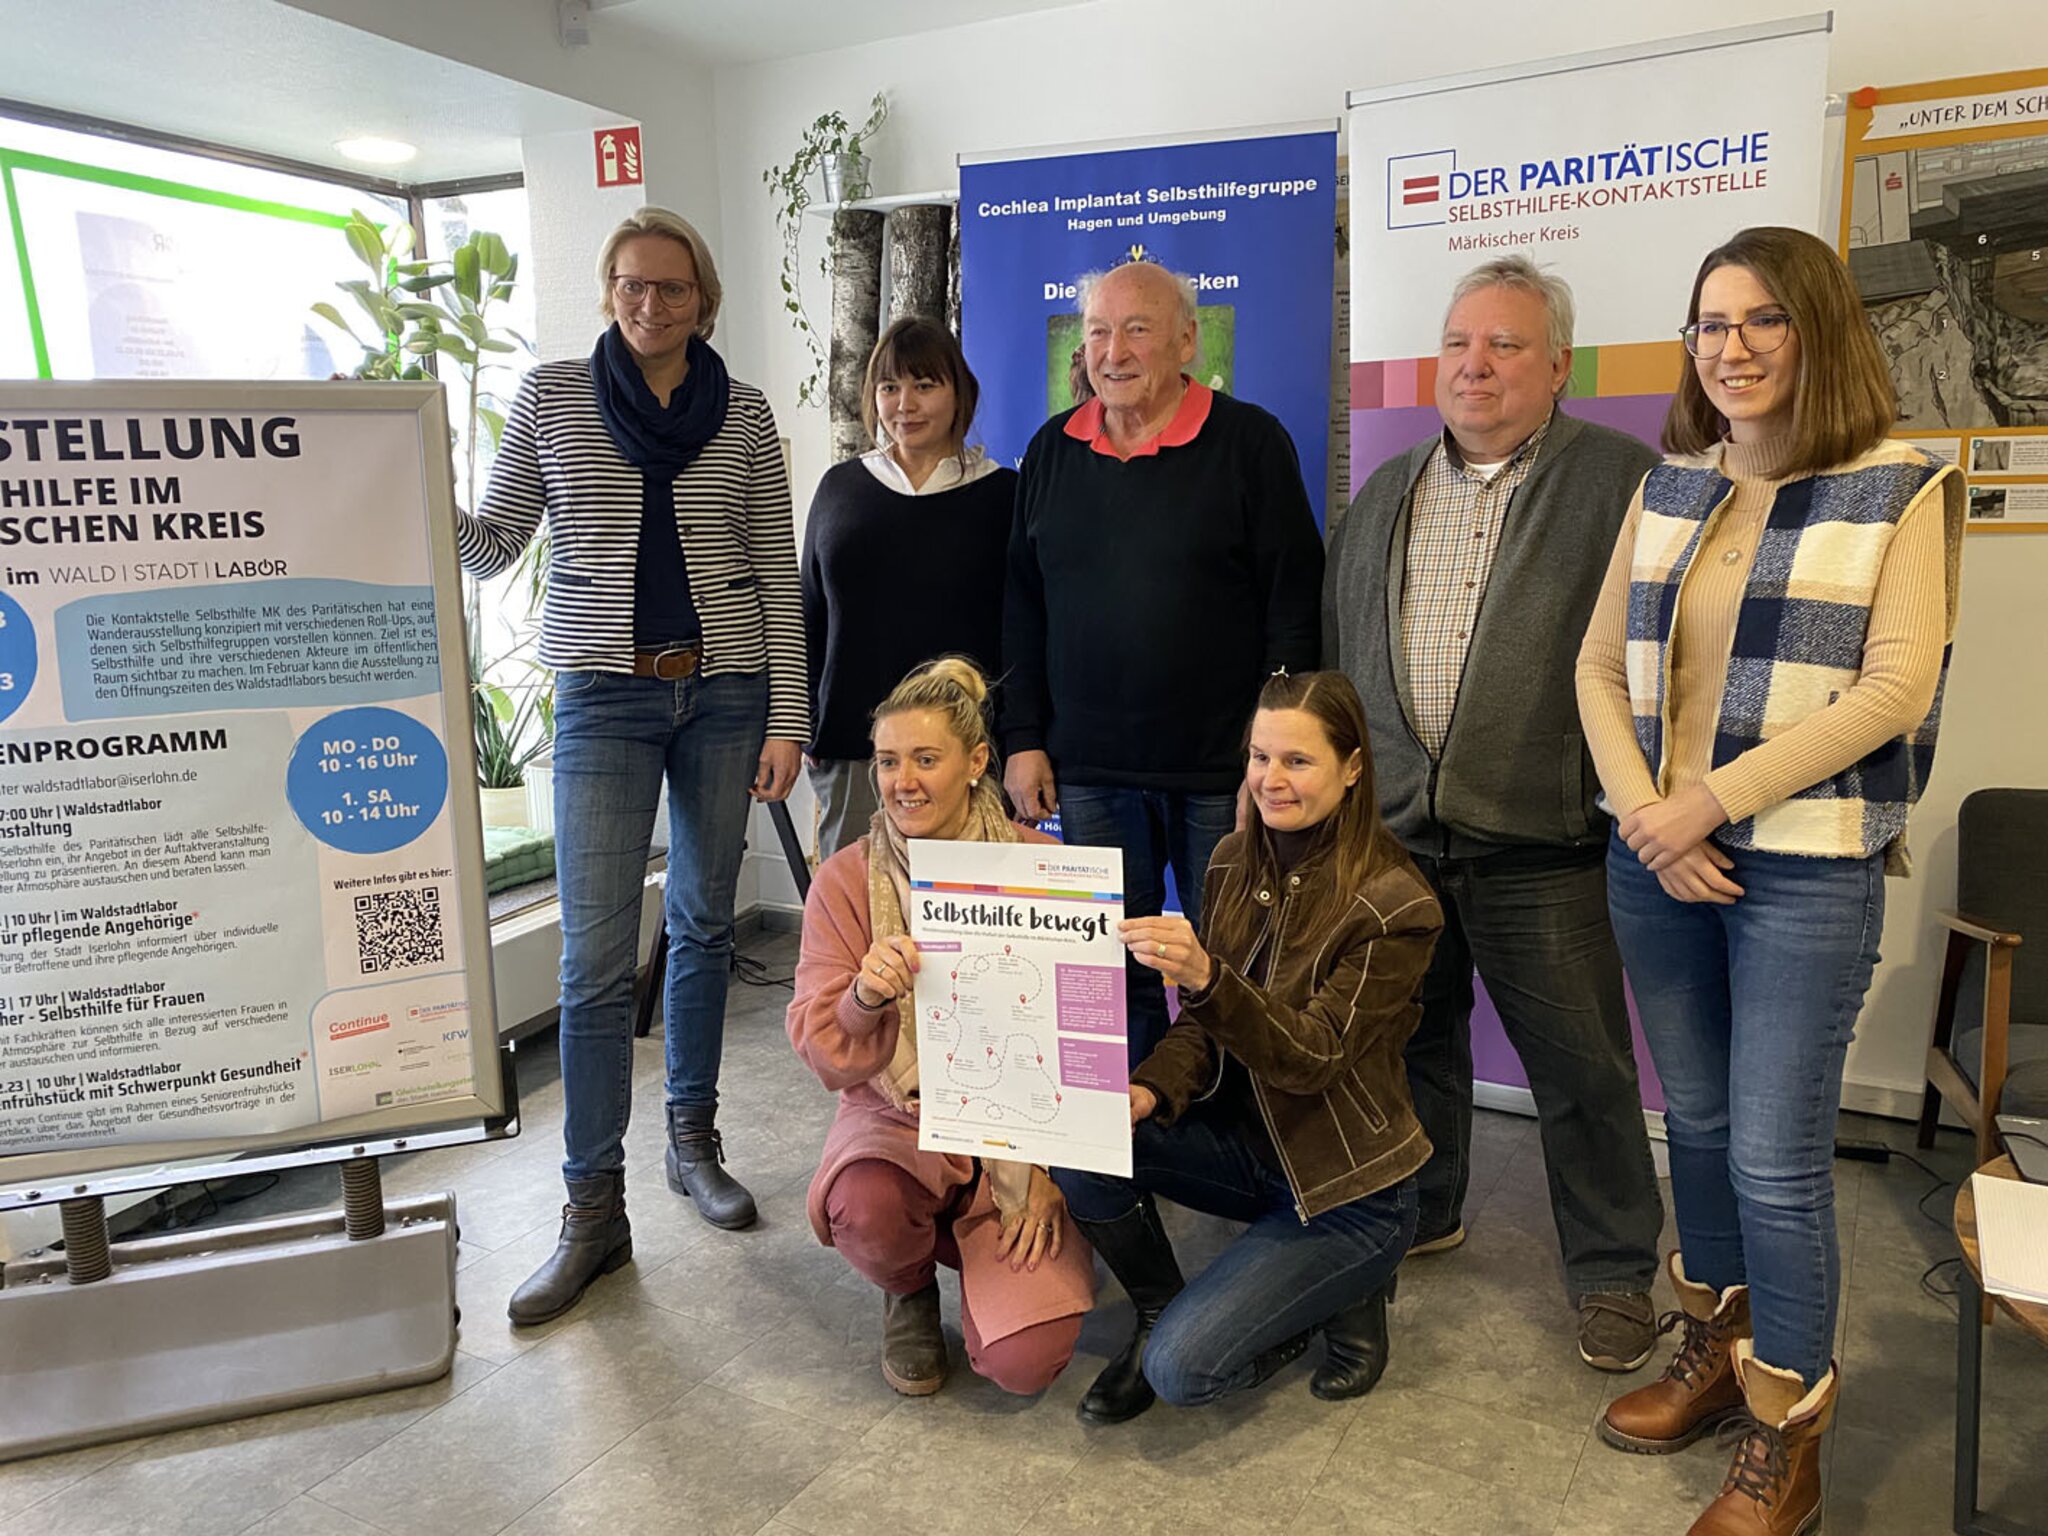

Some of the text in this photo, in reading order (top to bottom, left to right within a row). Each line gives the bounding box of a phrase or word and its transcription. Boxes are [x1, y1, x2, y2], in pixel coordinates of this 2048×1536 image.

[1973, 100, 2007, 120] DEM
[1449, 132, 1769, 200] DER PARITÄTISCHE
[978, 199, 1049, 218] Cochlea
[1054, 190, 1142, 212] Implantat
[1147, 178, 1317, 204] Selbsthilfegruppe
[1449, 169, 1767, 223] SELBSTHILFE-KONTAKTSTELLE
[1067, 207, 1226, 232] Hagen und Umgebung
[1449, 225, 1579, 252] Märkischer Kreis
[1977, 234, 1987, 245] 6
[2031, 250, 2041, 261] 5
[1043, 282, 1077, 301] Die
[0, 477, 181, 507] HILFE IM
[0, 511, 265, 545] SCHEN KREIS
[7, 568, 39, 585] im
[49, 564, 116, 584] WALD
[135, 561, 199, 581] STADT
[86, 600, 434, 626] Die Kontaktstelle Selbsthilfe MK des Paritätischen hat eine
[88, 625, 201, 641] Wanderausstellung
[205, 622, 261, 636] konzipiert
[264, 620, 282, 632] mit
[286, 616, 365, 630] verschiedenen
[417, 612, 435, 624] auf
[90, 643, 127, 656] denen
[132, 642, 155, 654] sich
[160, 636, 270, 654] Selbsthilfegruppen
[274, 631, 328, 646] vorstellen
[381, 628, 400, 640] Ziel
[404, 627, 416, 638] ist
[91, 656, 154, 670] Selbsthilfe
[161, 654, 183, 666] und
[189, 652, 213, 664] ihre
[217, 647, 300, 664] verschiedenen
[306, 644, 349, 658] Akteure
[354, 644, 368, 655] im
[93, 654, 439, 684] Raum sichtbar zu machen. Februar kann die Ausstellung zu
[95, 668, 417, 699] den des Waldstadtlabors besucht werden.
[322, 736, 400, 755] MO DO
[318, 752, 418, 773] 10 16 Uhr
[22, 769, 198, 795] waldstadtlabor@iserlohn.de
[30, 805, 54, 820] Uhr
[63, 798, 162, 817] Waldstadtlabor
[342, 789, 392, 806] 1. SA
[321, 803, 420, 825] 10 14 Uhr
[0, 843, 56, 857] Selbsthilfe
[63, 841, 82, 852] des
[191, 829, 208, 840] alle
[67, 836, 270, 864] ihr Angebot der Auftaktveranstaltung
[142, 848, 271, 869] diesem Abend kann man
[82, 865, 212, 887] austauschen und beraten
[334, 867, 453, 890] Weitere Infos gibt es hier:
[11, 900, 178, 926] 10 Uhr im Waldstadtlabor
[922, 900, 1023, 927] Selbsthilfe
[1030, 906, 1110, 942] bewegt
[22, 922, 101, 947] pflegende
[31, 922, 279, 960] der Stadt Iserlohn informiert individuelle
[14, 959, 70, 973] Betroffene
[72, 956, 92, 968] und
[95, 954, 115, 965] ihre
[117, 948, 169, 964] pflegende
[19, 981, 166, 1008] 17 Uhr Waldstadtlabor
[39, 1000, 122, 1022] Selbsthilfe
[126, 996, 149, 1012] für
[153, 992, 205, 1009] Frauen
[122, 1003, 275, 1031] sich alle interessierten Frauen
[165, 1012, 289, 1038] Bezug auf verschiedene
[329, 1013, 389, 1033] Continue
[9, 1042, 161, 1068] austauschen informieren.
[37, 1062, 182, 1089] 10 Uhr Waldstadtlabor
[89, 1083, 114, 1099] mit
[118, 1070, 216, 1097] Schwerpunkt
[39, 1096, 198, 1123] Continue eines
